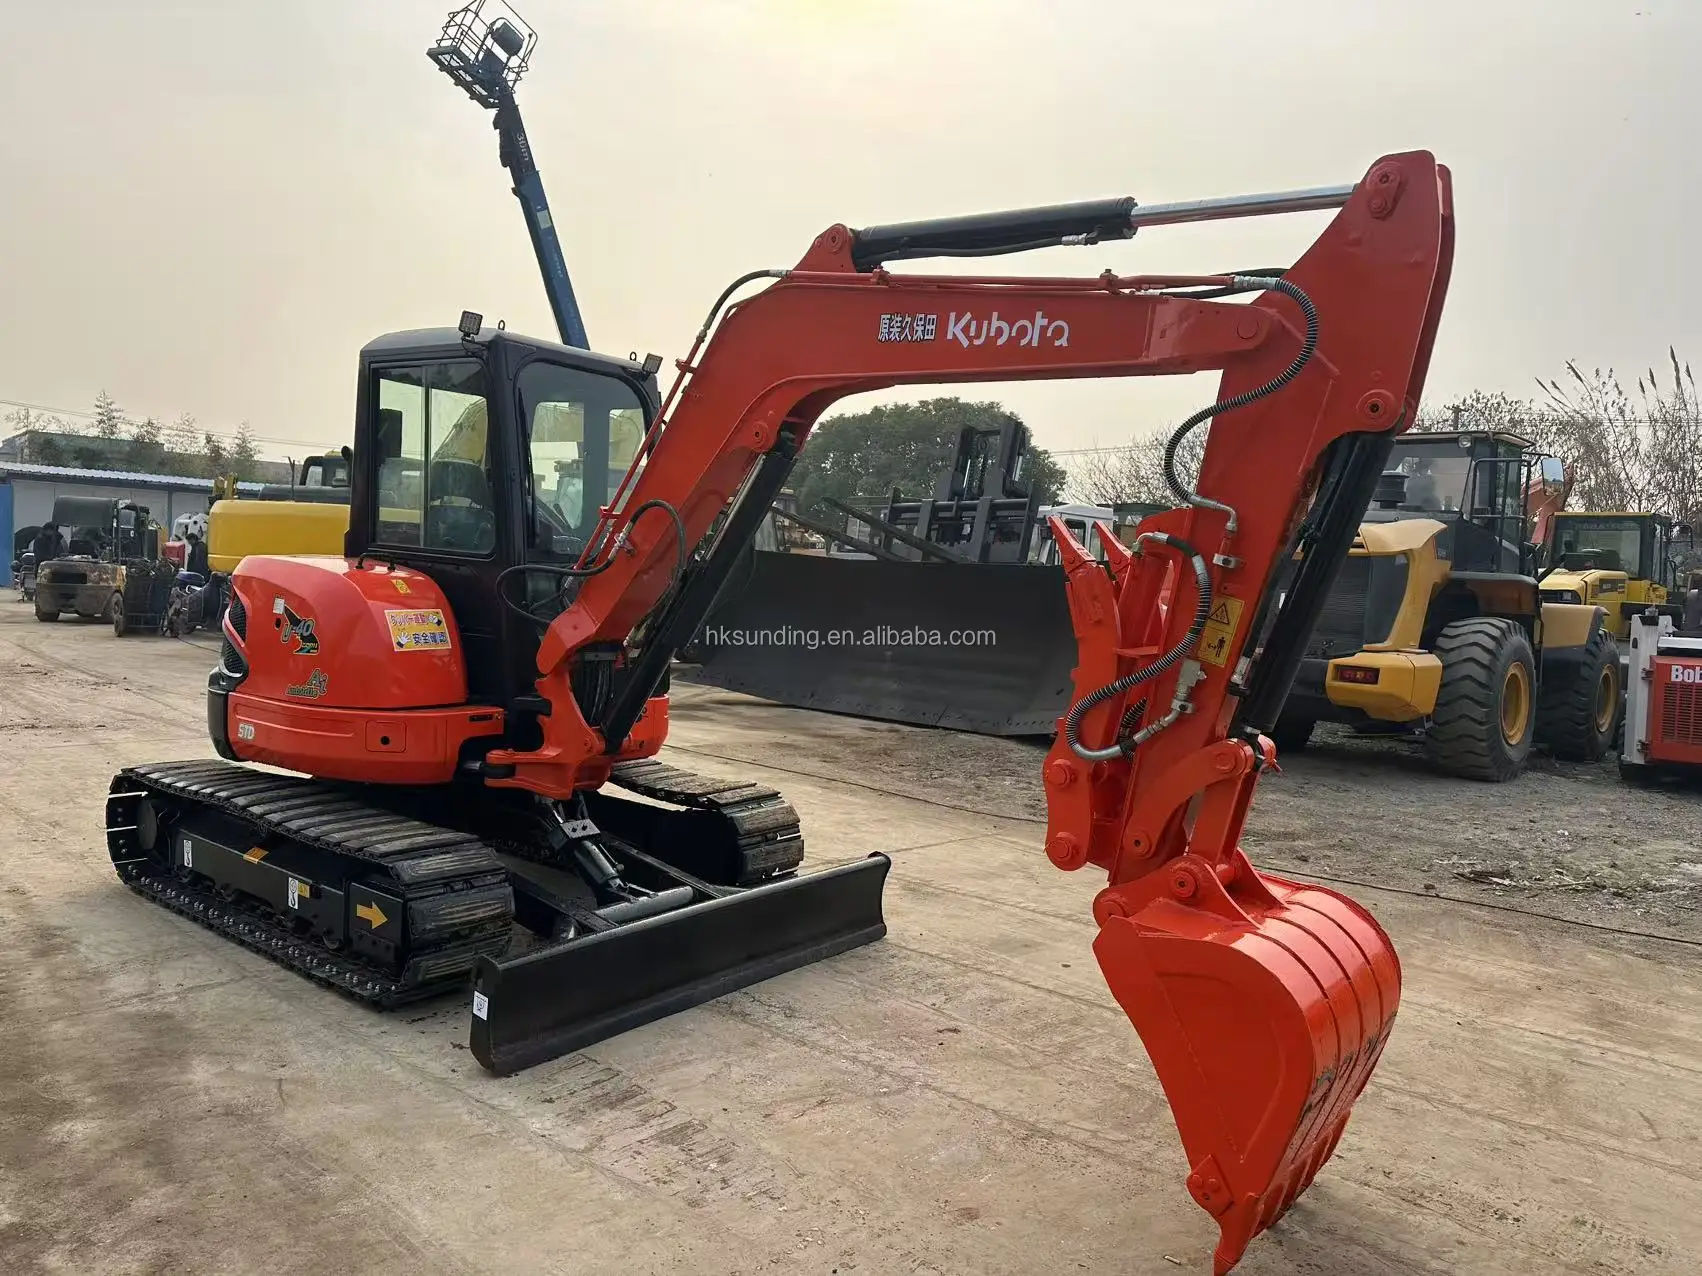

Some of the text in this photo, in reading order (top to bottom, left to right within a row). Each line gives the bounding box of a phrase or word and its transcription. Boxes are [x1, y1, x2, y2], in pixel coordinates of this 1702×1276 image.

[878, 314, 937, 341] 原装久保田
[946, 311, 1069, 348] Kubota
[412, 631, 448, 646] 安全
